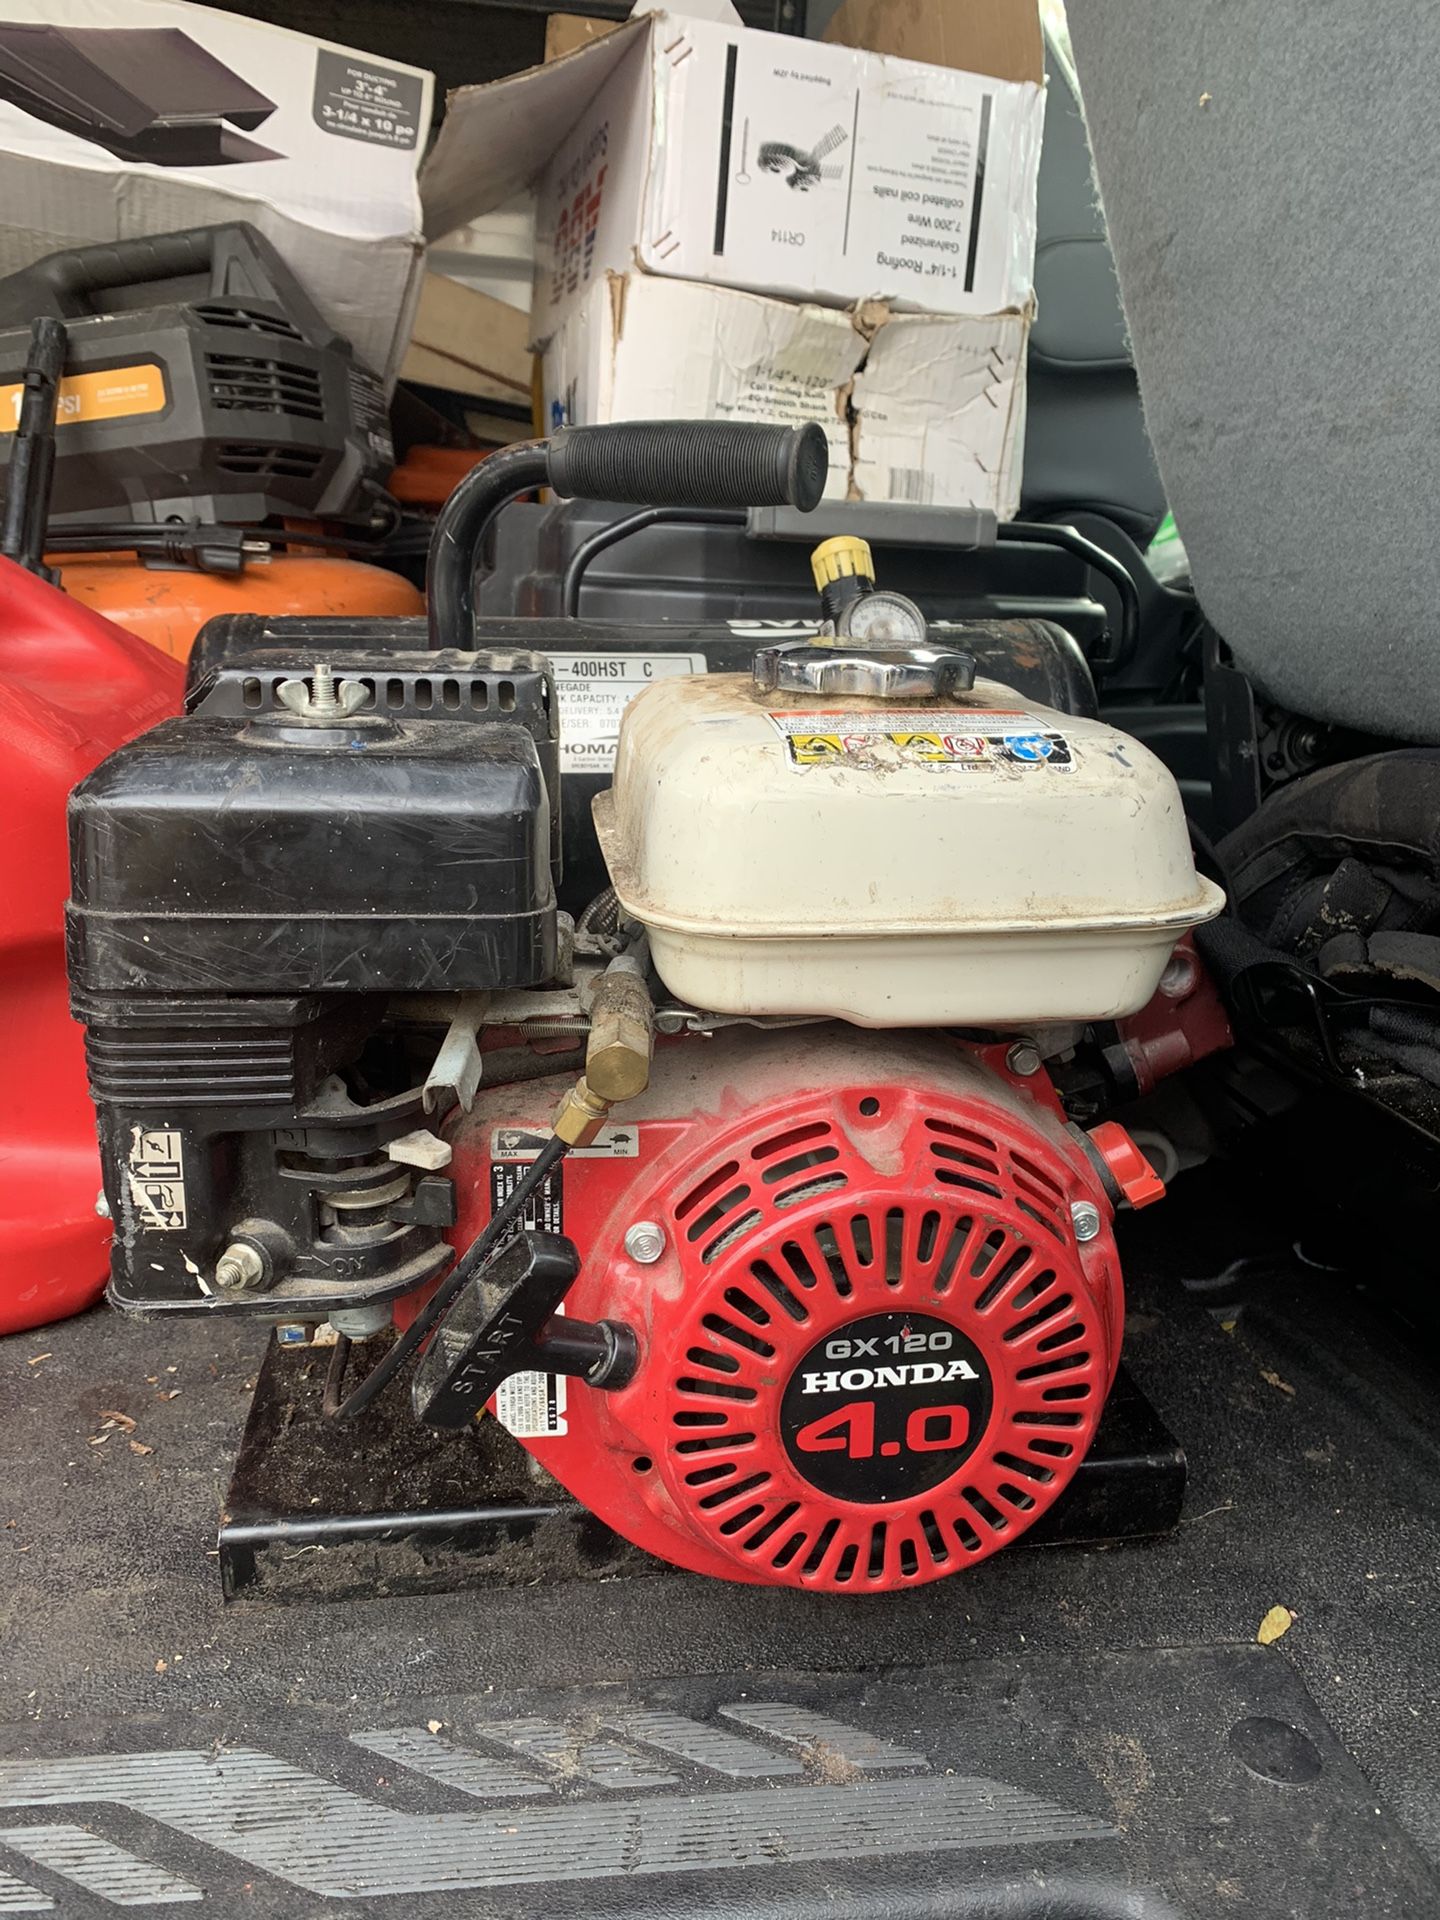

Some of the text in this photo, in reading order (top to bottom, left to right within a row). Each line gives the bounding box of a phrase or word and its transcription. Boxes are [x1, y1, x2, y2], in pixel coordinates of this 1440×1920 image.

[790, 70, 801, 81] by
[322, 104, 359, 124] 3-1/4
[361, 116, 372, 127] x
[375, 118, 394, 132] 10
[872, 184, 965, 209] collated coil nails
[907, 212, 933, 229] Wire
[771, 229, 805, 247] CR114
[901, 233, 960, 255] Galvanized
[876, 251, 958, 279] 1-1/4" Roofing
[755, 365, 791, 382] 1-1/4"
[643, 661, 653, 678] C
[559, 743, 618, 756] HOMA
[493, 1165, 504, 1173] 3
[516, 1165, 524, 1181] CLEAN
[496, 1181, 504, 1198] INDEX
[506, 1174, 514, 1199] ABILITY.
[331, 1256, 367, 1275] ON
[451, 1312, 523, 1395] START
[825, 1331, 953, 1360] GX120
[801, 1359, 980, 1394] HONDA
[524, 1385, 531, 1393] TO
[524, 1407, 532, 1422] HOURS
[796, 1401, 970, 1459] 4.0
